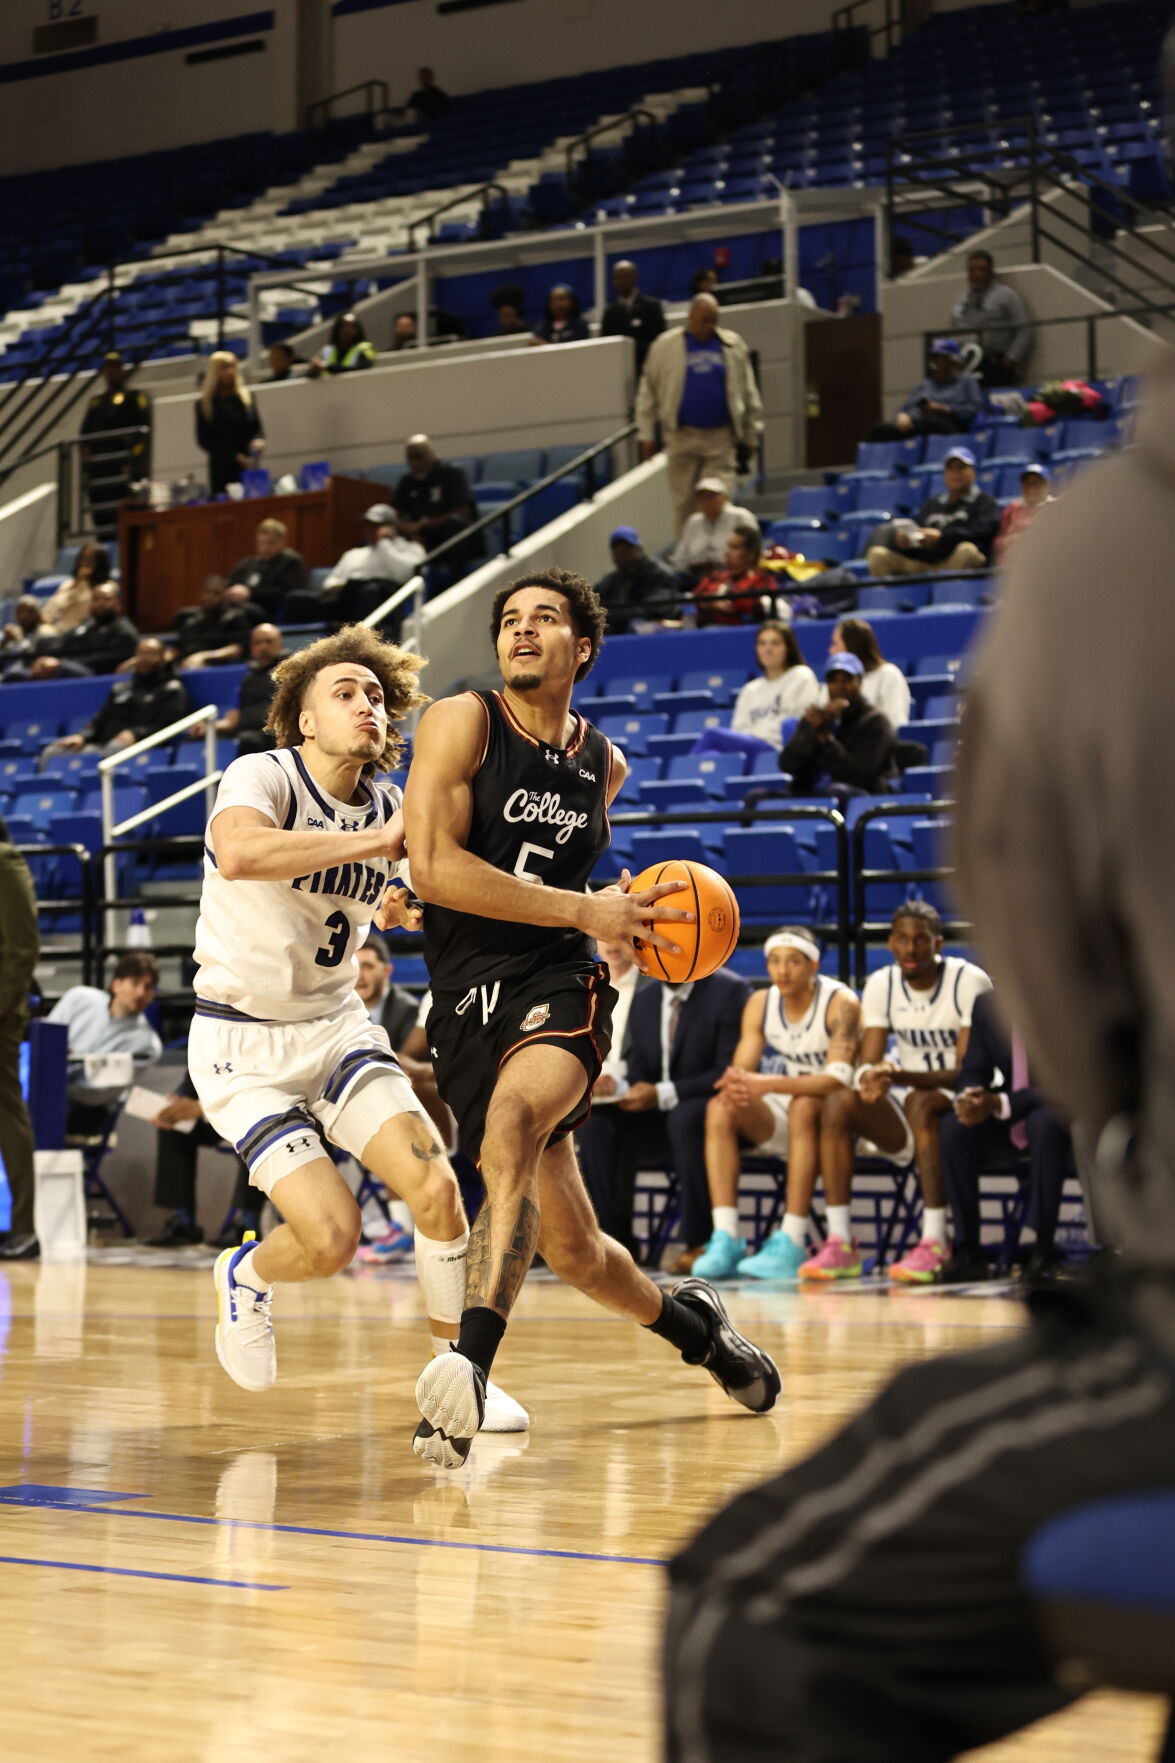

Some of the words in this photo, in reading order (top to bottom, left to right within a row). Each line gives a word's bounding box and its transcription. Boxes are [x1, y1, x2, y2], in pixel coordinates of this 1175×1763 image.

[578, 769, 596, 782] CAA
[529, 791, 541, 801] The
[307, 817, 324, 829] CAA
[503, 788, 588, 845] College
[513, 841, 555, 886] 5
[314, 910, 351, 968] 3
[923, 1052, 946, 1073] 11
